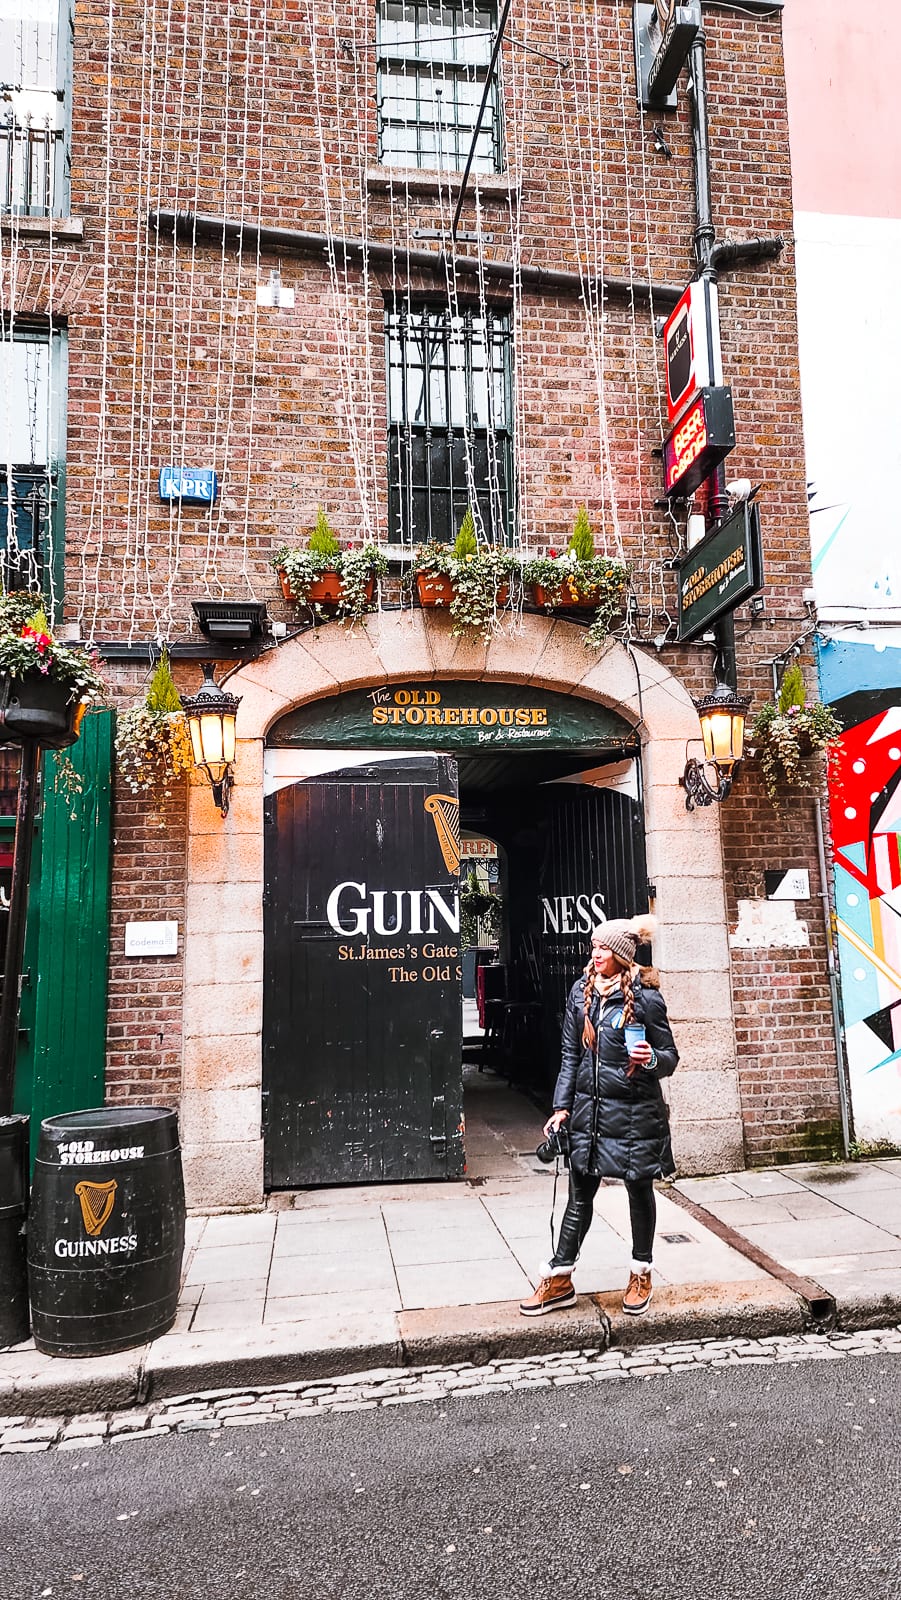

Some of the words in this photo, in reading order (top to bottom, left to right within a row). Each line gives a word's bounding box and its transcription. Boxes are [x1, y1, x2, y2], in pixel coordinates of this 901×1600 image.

[674, 408, 704, 457] BEER
[164, 478, 212, 499] KPR
[682, 544, 744, 611] STOREHOUSE
[688, 566, 705, 589] OLD
[367, 686, 391, 705] The
[394, 690, 441, 705] OLD
[372, 707, 548, 726] STOREHOUSE
[478, 731, 494, 742] Bar
[495, 729, 503, 740] &
[507, 728, 551, 739] Restaurant
[326, 881, 461, 937] GUIN
[541, 893, 607, 934] NESS
[338, 943, 418, 960] St.James's
[422, 943, 458, 959] Gate
[388, 966, 418, 982] The
[422, 966, 450, 982] Old
[60, 1146, 145, 1165] STOREHOUSE
[68, 1141, 94, 1153] OLD
[54, 1234, 138, 1258] GUINNESS
